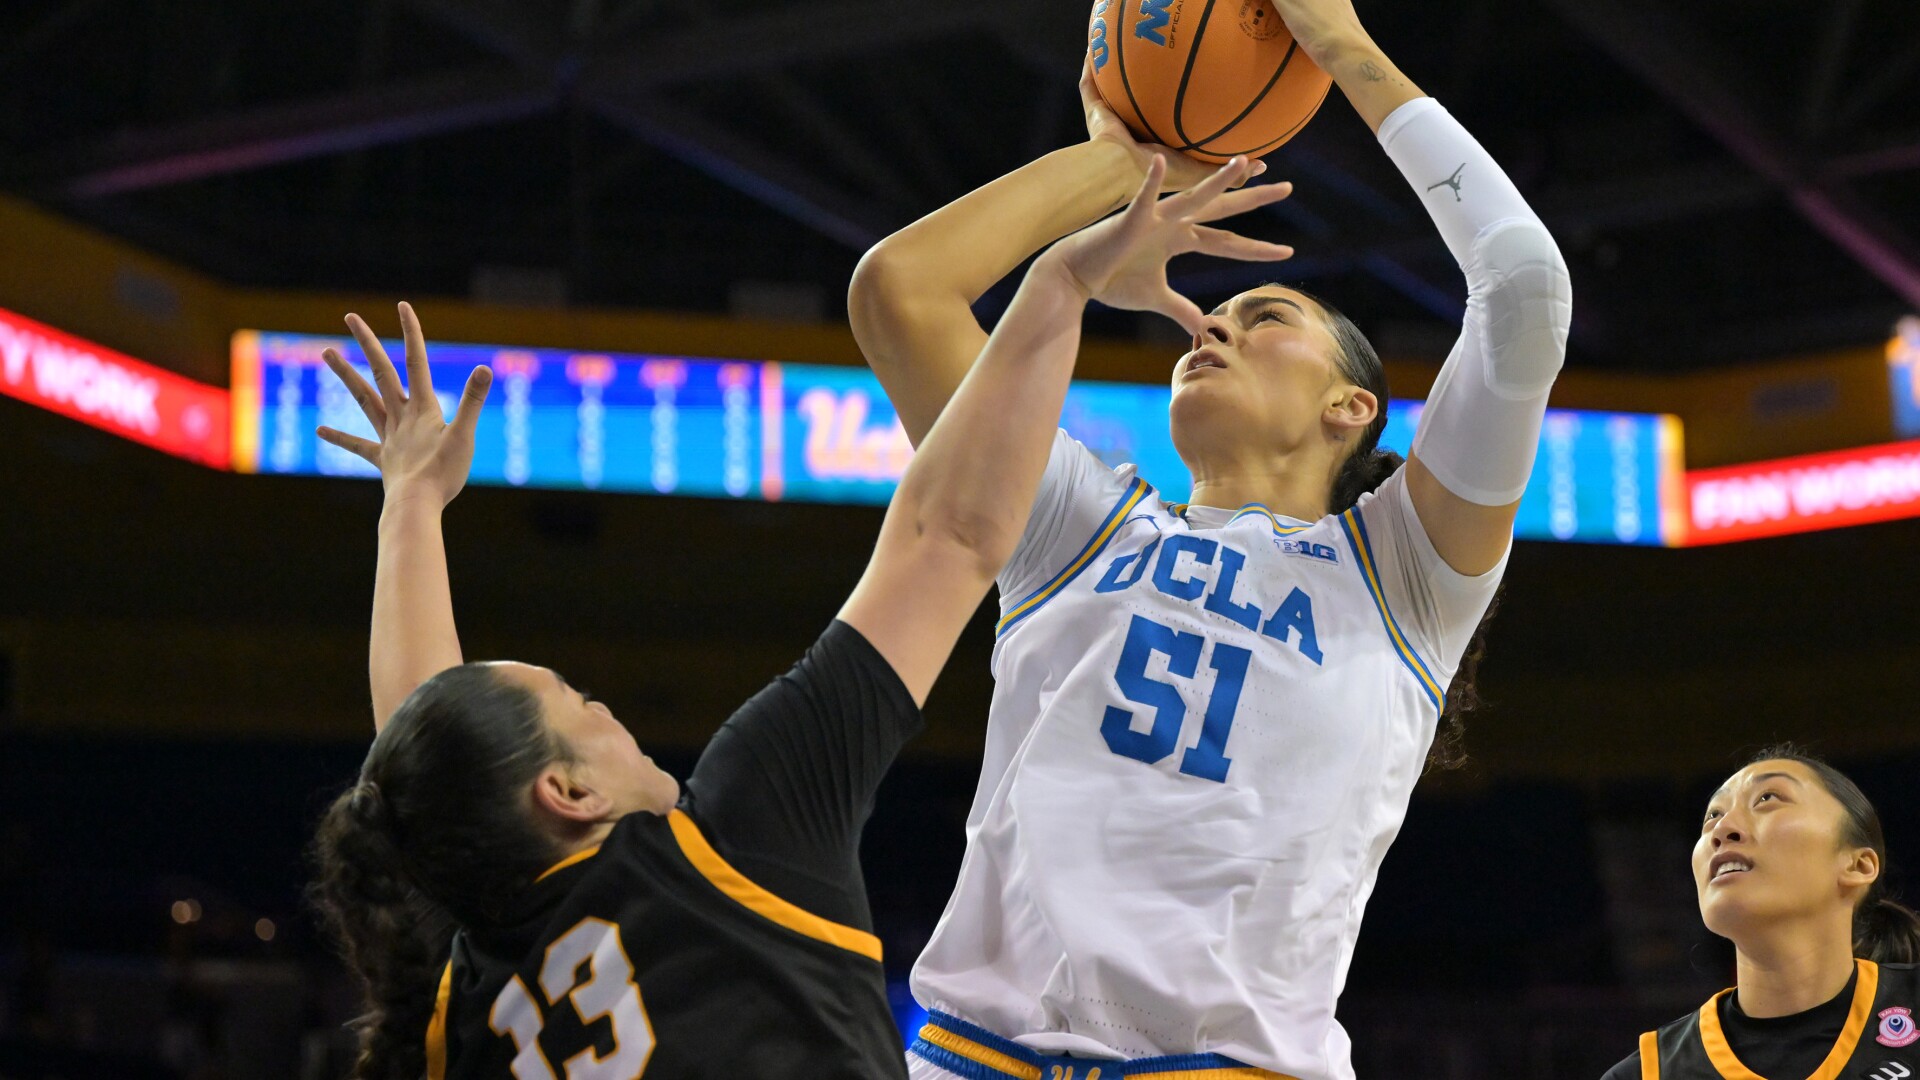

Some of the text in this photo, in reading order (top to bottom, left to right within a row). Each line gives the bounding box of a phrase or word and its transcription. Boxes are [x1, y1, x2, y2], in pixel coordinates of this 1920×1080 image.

[1094, 533, 1324, 666] UCLA
[1100, 614, 1252, 783] 51
[488, 915, 656, 1080] 13
